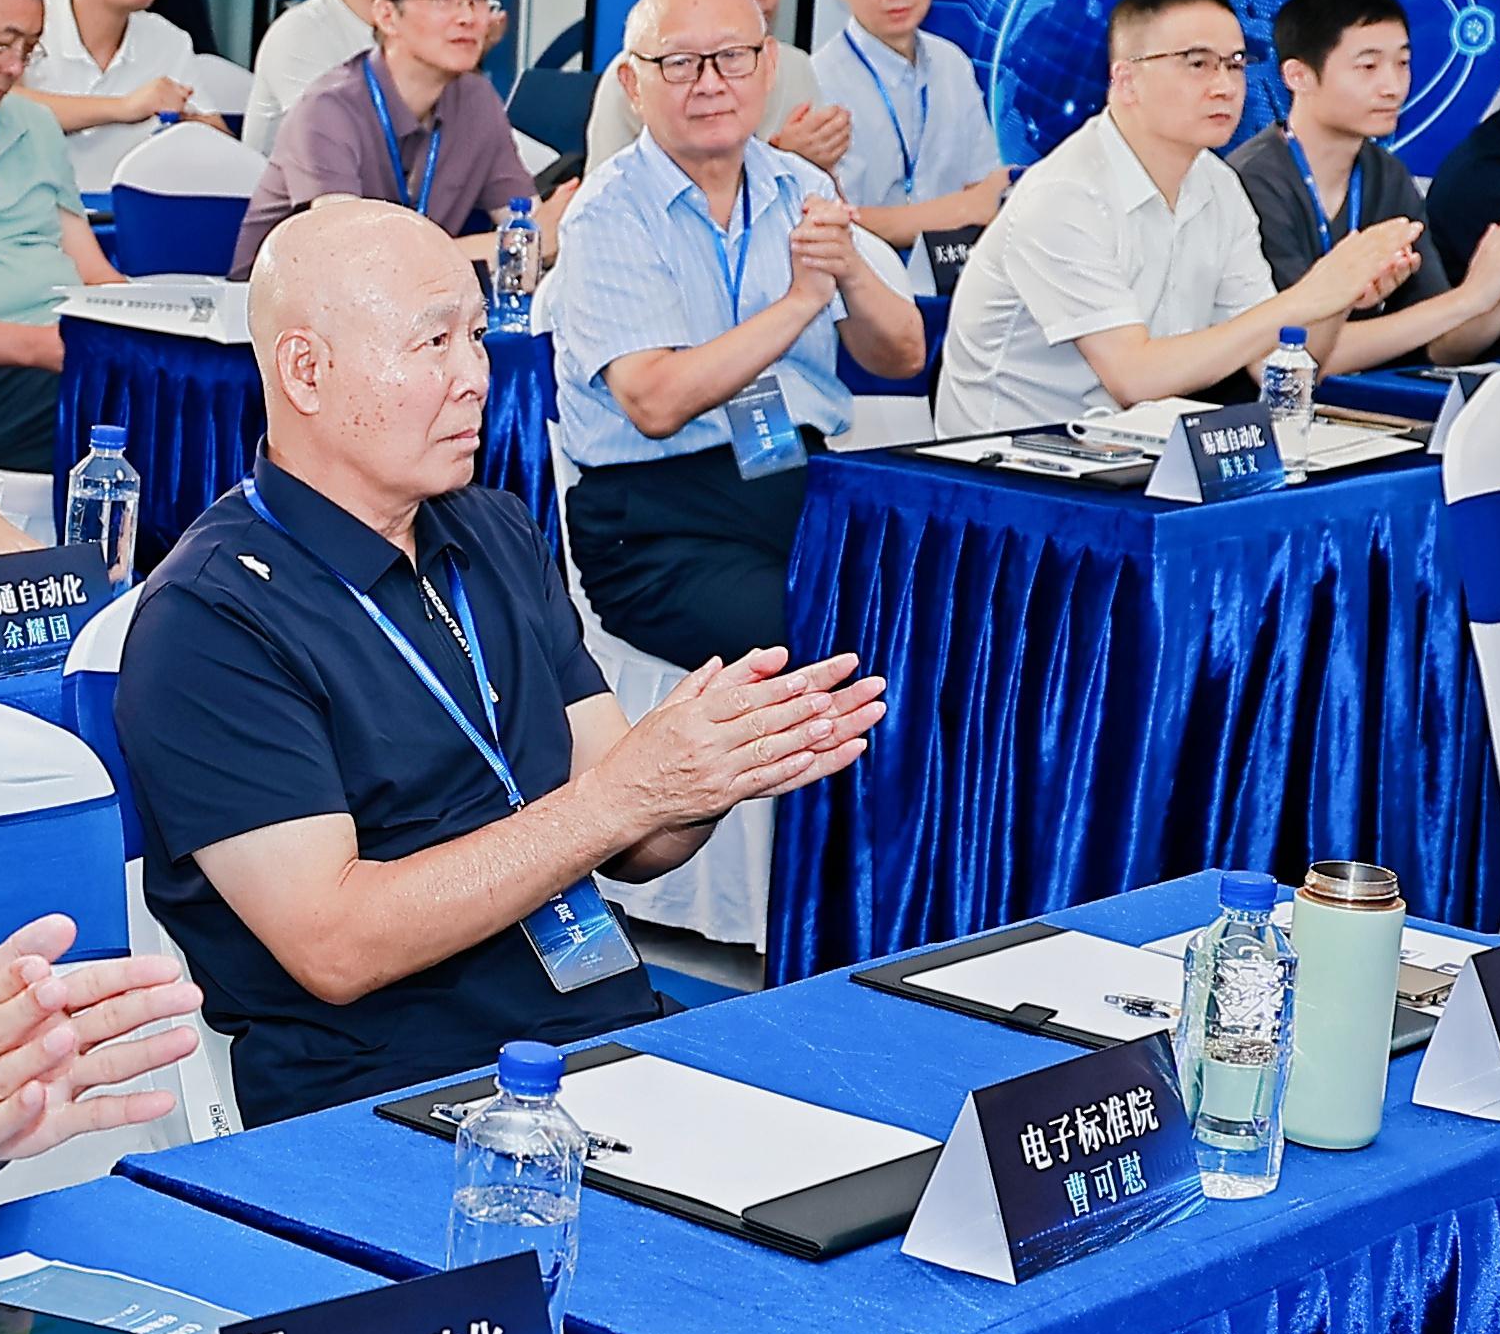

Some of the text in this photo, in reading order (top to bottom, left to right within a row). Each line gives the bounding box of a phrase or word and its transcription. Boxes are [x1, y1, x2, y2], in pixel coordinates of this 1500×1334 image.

[3, 614, 71, 649] 余耀国
[1020, 1087, 1159, 1170] 电子标准院
[1063, 1151, 1147, 1217] 曹可慰
